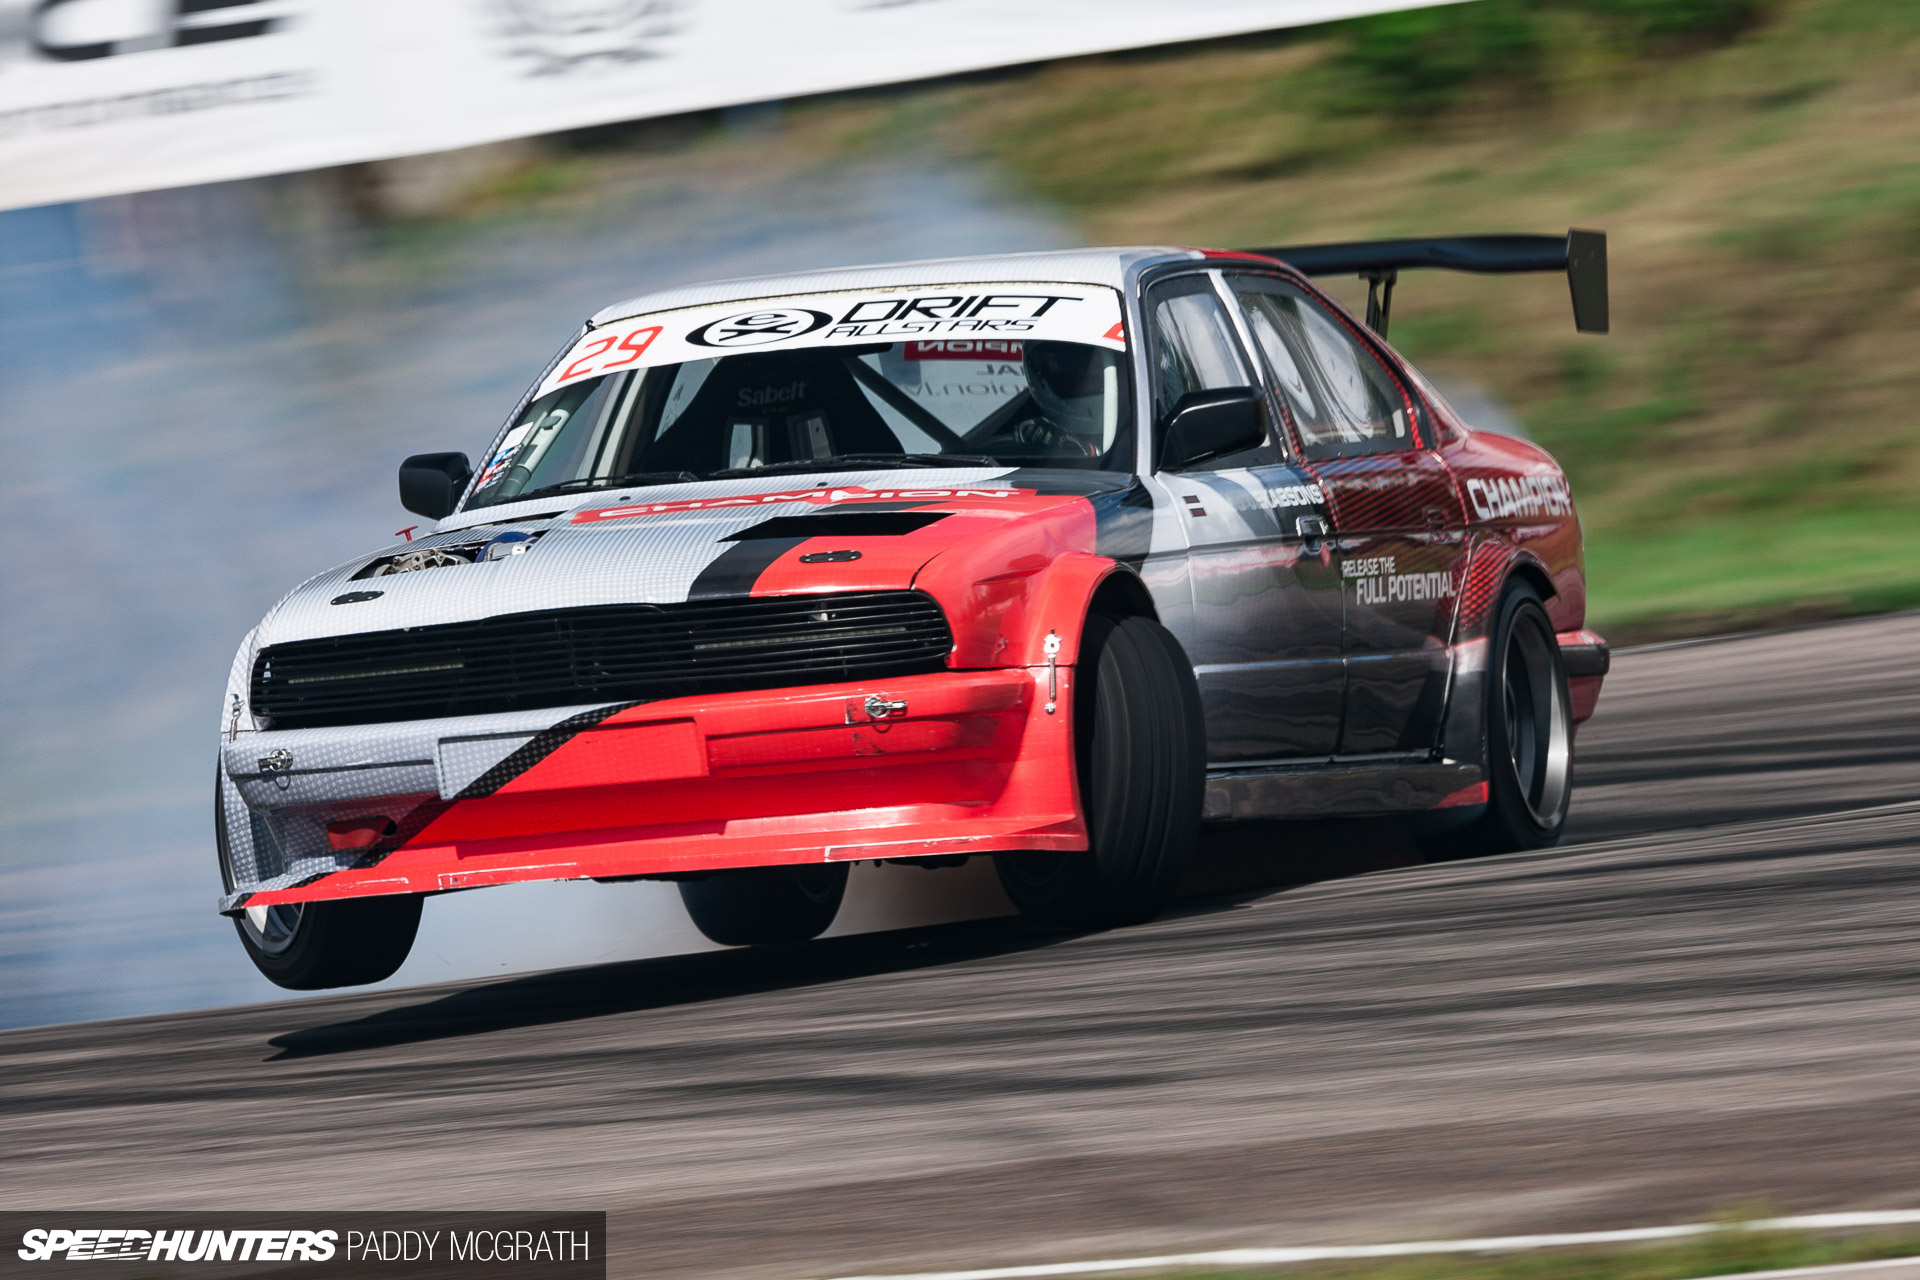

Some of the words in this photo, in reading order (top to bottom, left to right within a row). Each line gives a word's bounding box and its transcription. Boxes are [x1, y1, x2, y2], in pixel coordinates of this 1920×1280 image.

[836, 294, 1084, 325] DRIFT
[824, 318, 1039, 338] ALLSTARS
[556, 325, 664, 384] 29
[736, 381, 807, 408] Sabelt
[598, 488, 1021, 519] CHAMPION
[1466, 476, 1573, 520] CHAMPION
[1341, 557, 1380, 578] RELEASE
[1379, 556, 1396, 575] THE
[1356, 576, 1387, 606] FULL
[1388, 571, 1457, 602] POTENTIAL
